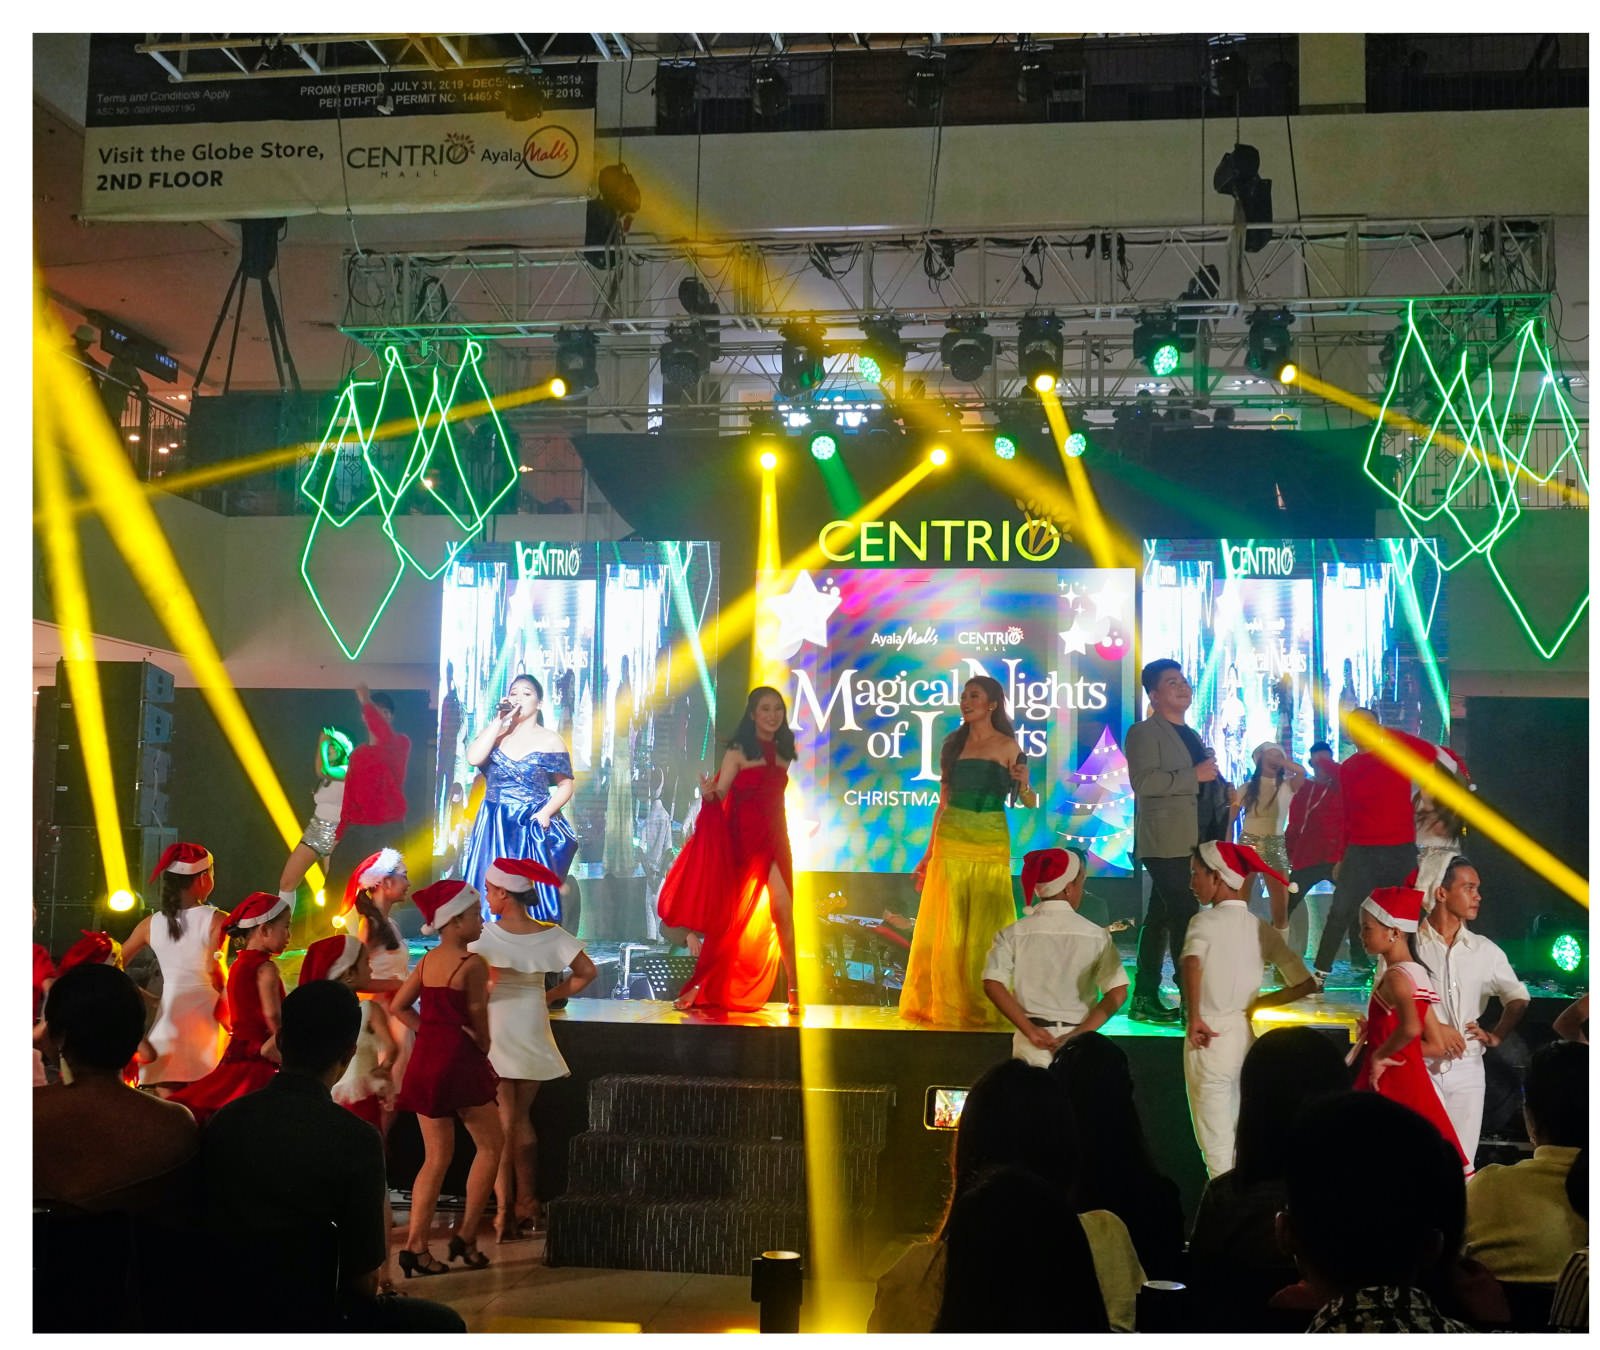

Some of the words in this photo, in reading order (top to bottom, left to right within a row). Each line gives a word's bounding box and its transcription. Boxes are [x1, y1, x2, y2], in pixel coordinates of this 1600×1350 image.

[97, 93, 127, 104] Terms
[129, 91, 149, 102] and
[150, 89, 201, 102] Conditions
[203, 88, 231, 100] Apply
[390, 80, 419, 92] JULY
[395, 93, 437, 105] PERMIT
[98, 147, 144, 164] Visit
[151, 146, 185, 162] the
[192, 143, 254, 161] Globe
[261, 142, 324, 161] Store,
[347, 142, 470, 170] CENTRIO
[480, 147, 523, 164] Ayala
[520, 140, 569, 164] Malls
[96, 173, 142, 191] 2ND
[149, 170, 223, 189] FLOOR
[818, 520, 1060, 562] CENTRIO
[523, 548, 580, 577] CENTRIO
[1230, 546, 1294, 576] CENTRIO
[871, 632, 902, 647] Ayala
[897, 626, 938, 651] Malls
[958, 628, 1023, 646] CENTRIO
[788, 664, 960, 732] Magical
[866, 721, 909, 759] of
[843, 790, 940, 807] CHRISTMA
